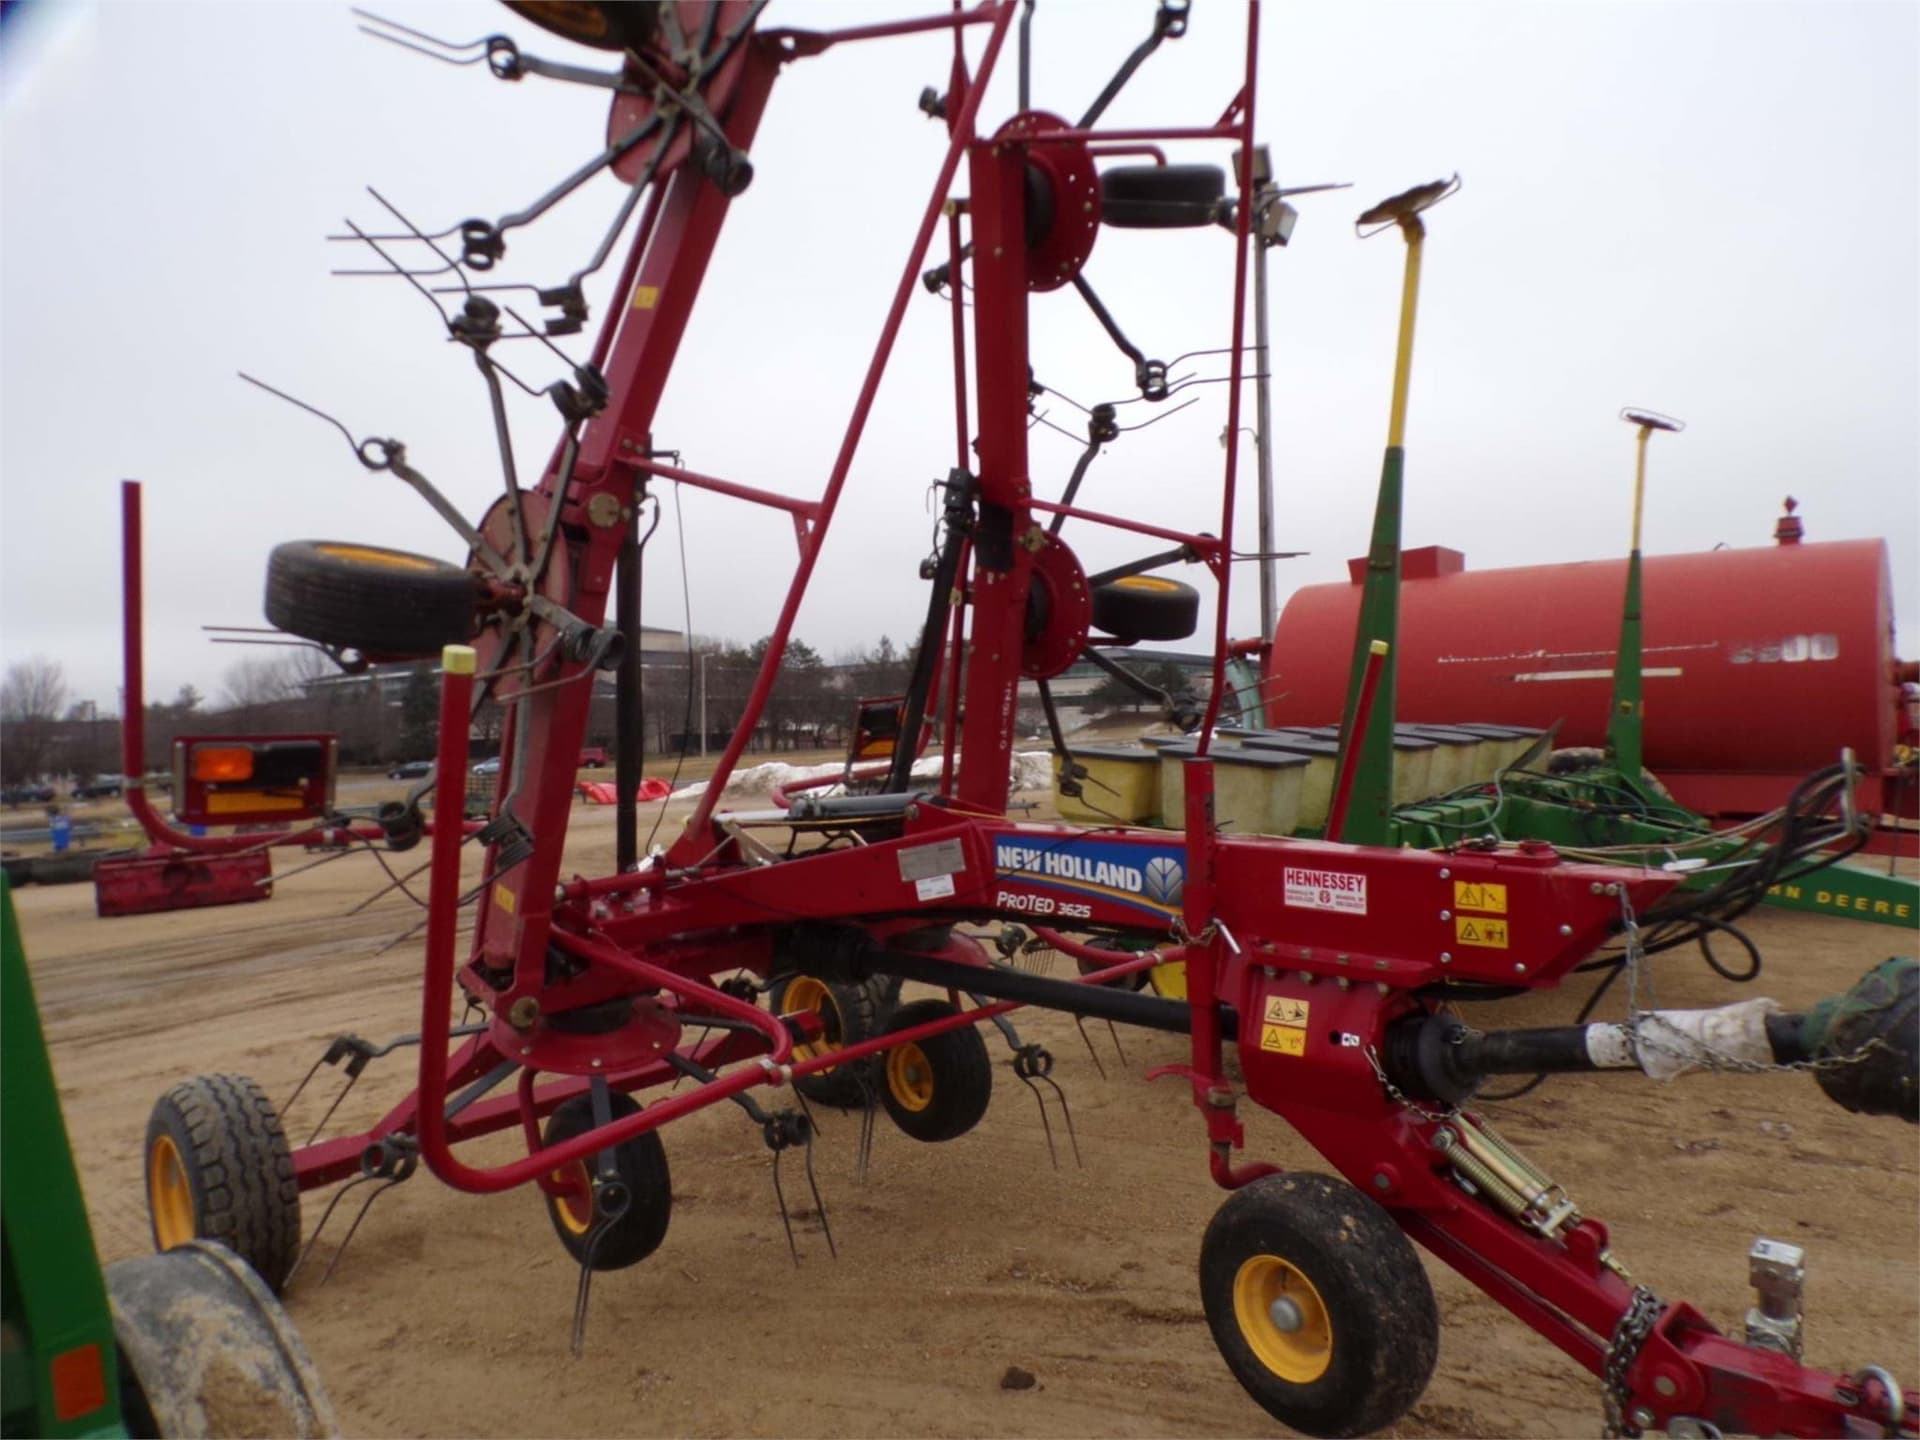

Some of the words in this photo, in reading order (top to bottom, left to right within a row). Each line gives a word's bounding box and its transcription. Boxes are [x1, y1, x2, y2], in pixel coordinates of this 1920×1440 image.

[997, 845, 1042, 872] NEW
[1044, 851, 1143, 893] HOLLAND
[1286, 869, 1364, 893] HENNESSEY
[1057, 902, 1092, 918] 3625
[1815, 891, 1911, 918] DEERE
